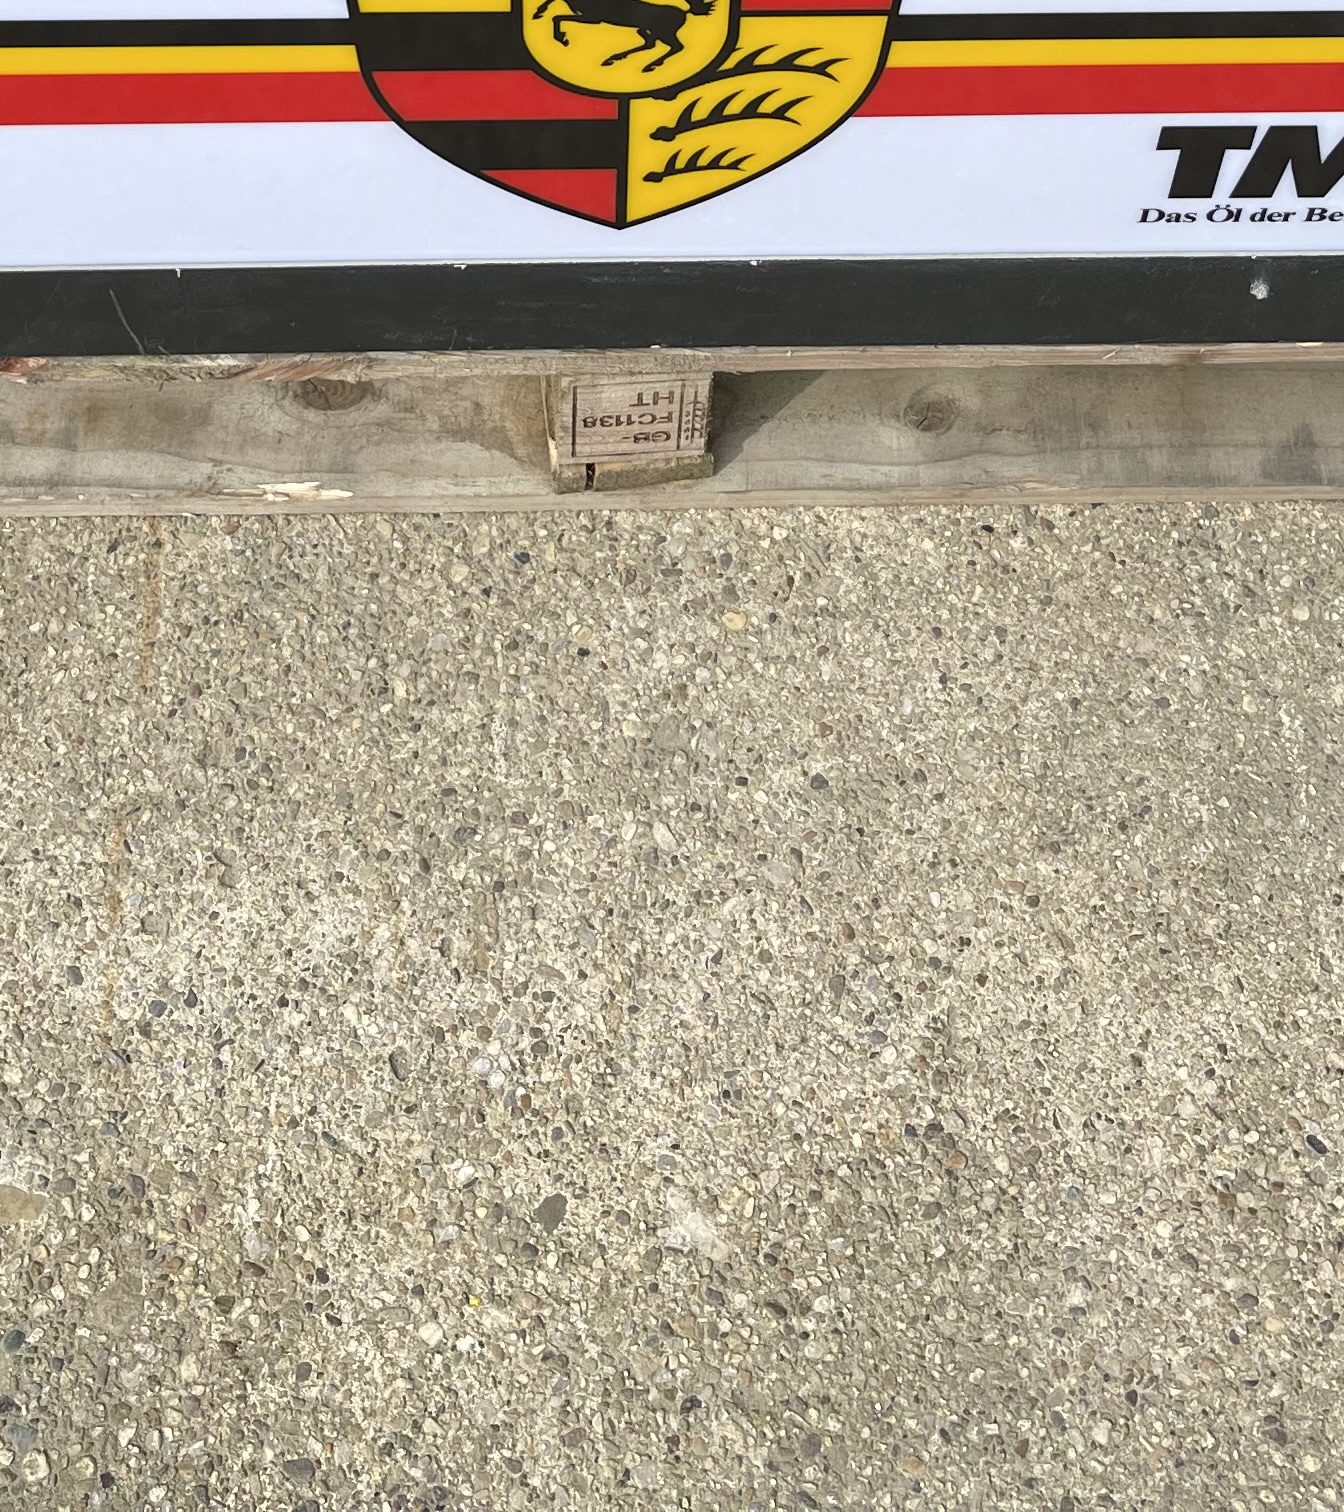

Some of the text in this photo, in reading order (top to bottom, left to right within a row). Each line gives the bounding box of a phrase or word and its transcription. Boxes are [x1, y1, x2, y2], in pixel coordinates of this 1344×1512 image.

[1137, 207, 1197, 225] Das
[1205, 203, 1242, 225] Öl
[1248, 206, 1297, 225] der
[628, 390, 675, 407] HT
[582, 411, 674, 429] FC1138
